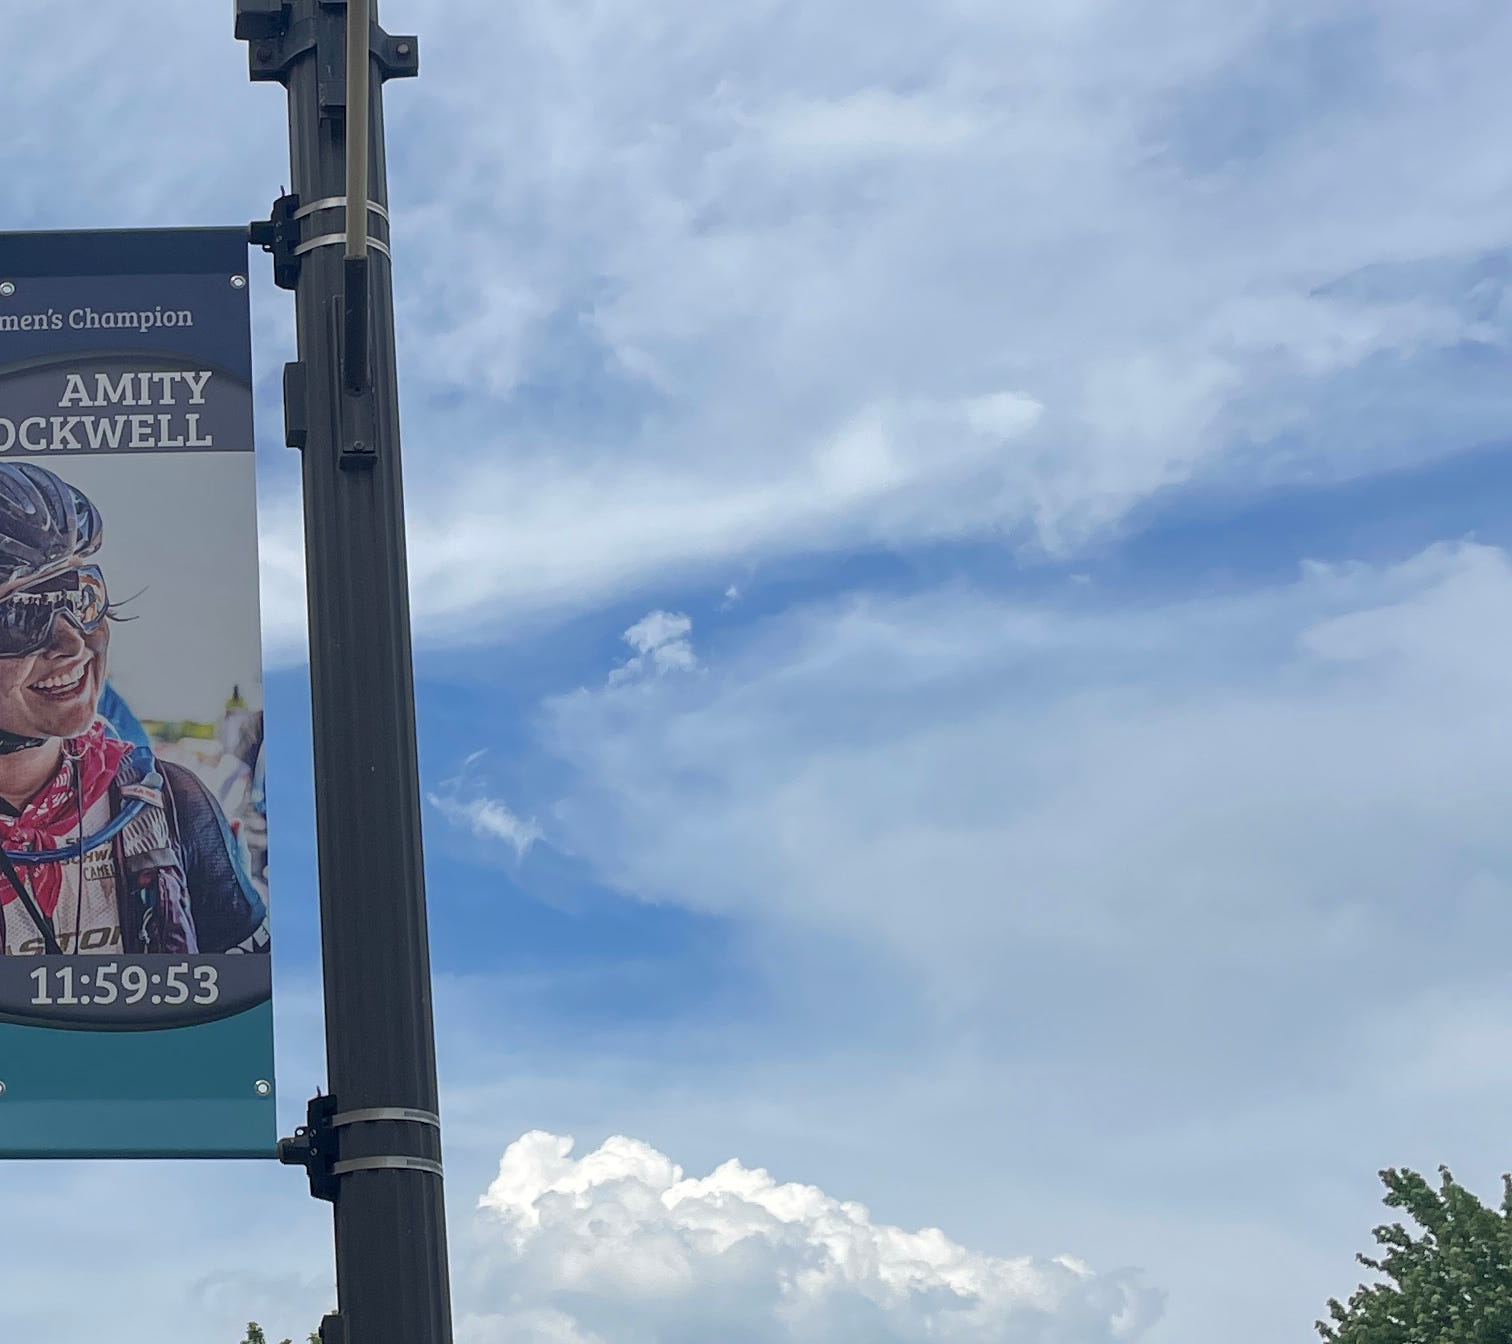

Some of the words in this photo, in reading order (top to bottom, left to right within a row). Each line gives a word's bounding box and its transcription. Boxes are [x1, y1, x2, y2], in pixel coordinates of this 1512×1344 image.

[68, 306, 194, 333] Champion
[58, 371, 213, 407] AMITY
[30, 962, 220, 1005] 11:59:53
